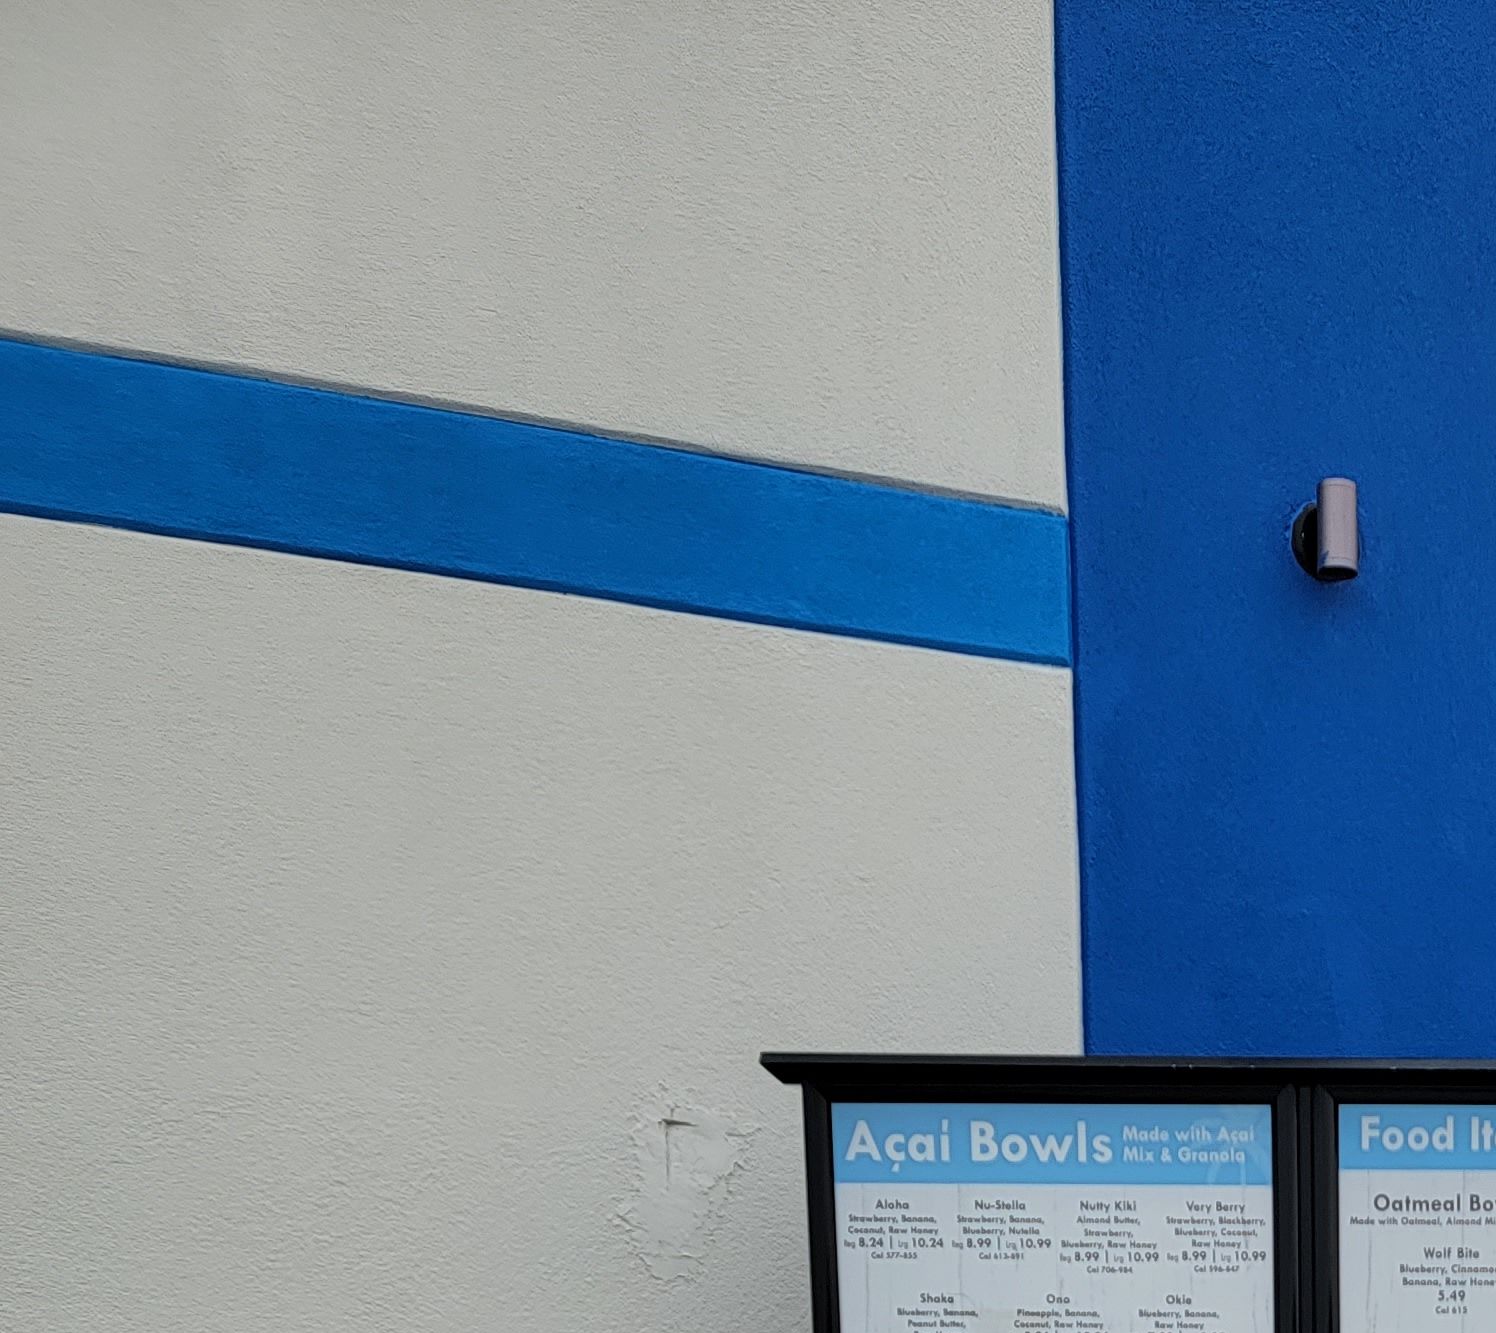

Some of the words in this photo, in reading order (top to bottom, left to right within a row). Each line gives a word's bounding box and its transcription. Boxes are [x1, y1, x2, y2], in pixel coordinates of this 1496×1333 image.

[1123, 1126, 1169, 1142] Made
[1175, 1126, 1212, 1142] with
[1361, 1116, 1454, 1152] Food
[970, 1121, 1113, 1163] Bowls
[1123, 1146, 1154, 1162] Mix
[1161, 1147, 1172, 1162] &
[1178, 1147, 1245, 1163] Granola
[875, 1199, 910, 1210] Aloha
[1080, 1200, 1110, 1213] Nutty
[1114, 1200, 1136, 1212] Kiki
[1186, 1200, 1212, 1214] Very
[1216, 1201, 1246, 1214] Berry
[1374, 1194, 1461, 1212] Oatmeal
[858, 1237, 884, 1248] 8.24
[912, 1237, 944, 1248] 10.24
[966, 1238, 992, 1248] 8.99
[1020, 1238, 1052, 1248] 10.99
[1457, 1247, 1480, 1259] Bite
[920, 1293, 954, 1304] Shaka
[1438, 1290, 1466, 1302] 5.49
